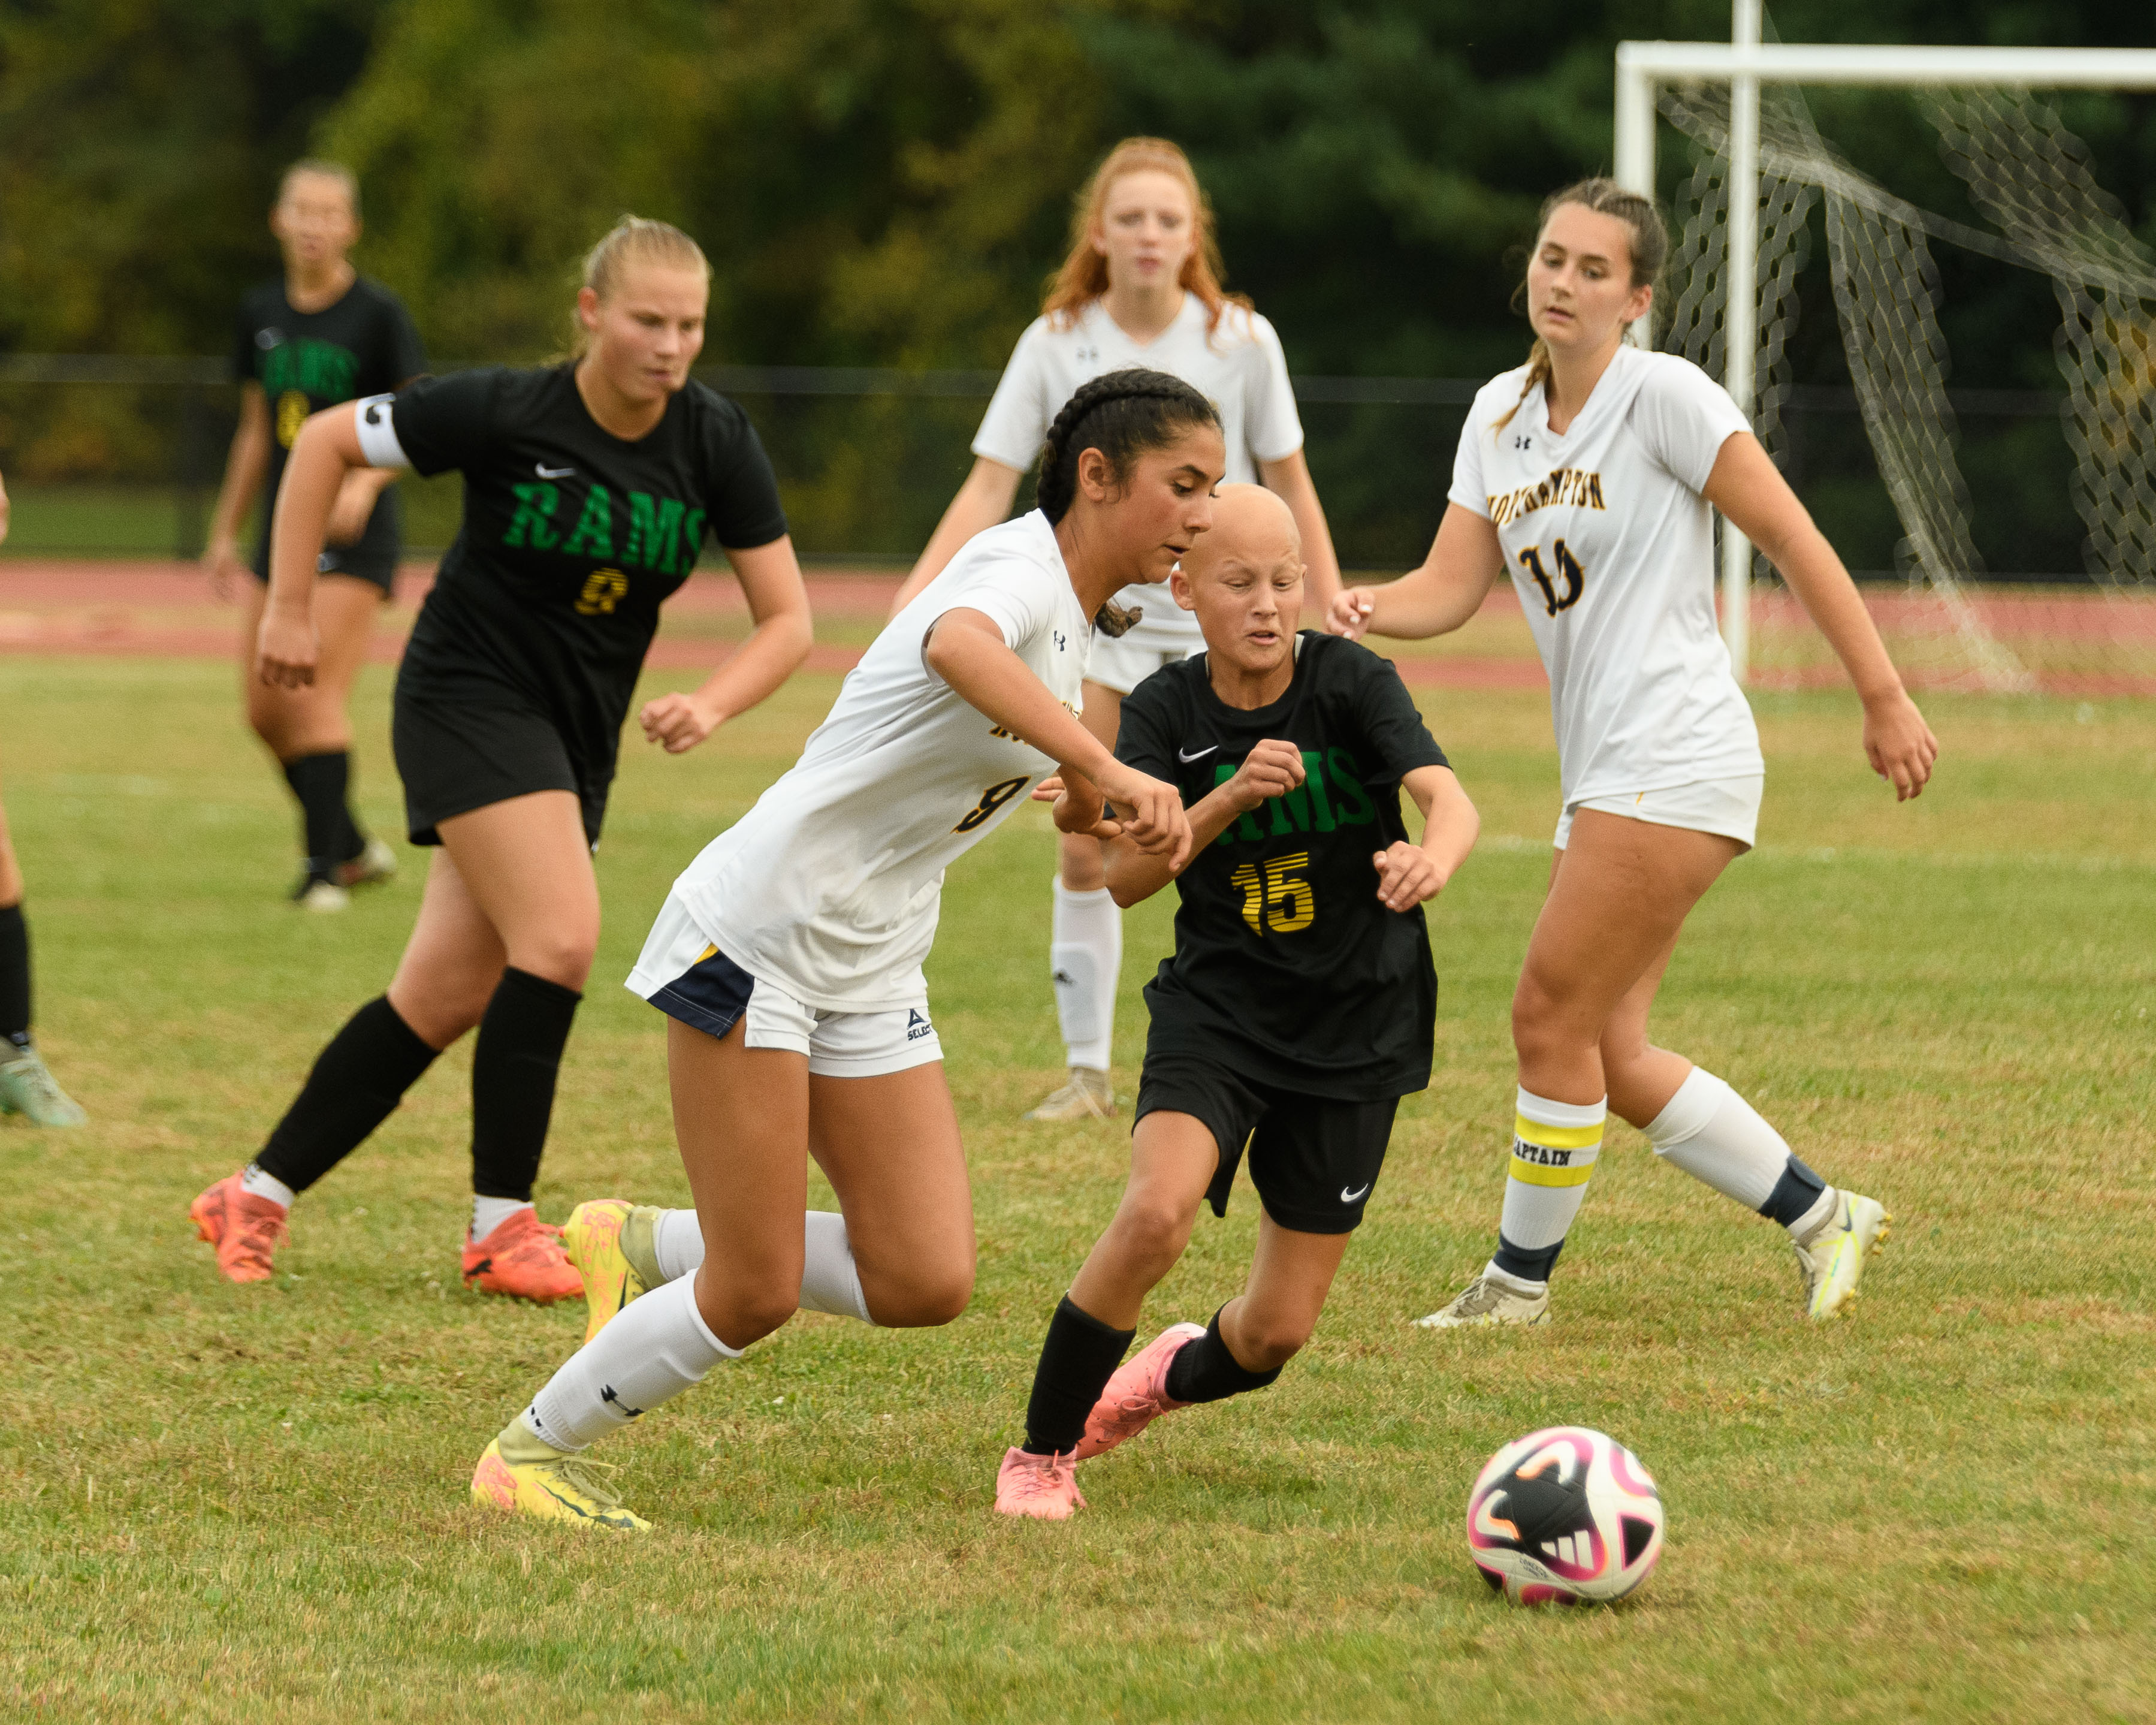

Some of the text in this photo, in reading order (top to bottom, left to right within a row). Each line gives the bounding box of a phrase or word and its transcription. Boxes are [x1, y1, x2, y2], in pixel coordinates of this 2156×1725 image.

[503, 482, 706, 577] RAMS
[950, 775, 1031, 834] 9
[1209, 746, 1376, 846] AMS
[1230, 851, 1315, 937] 15
[1514, 1136, 1572, 1166] APTAIN
